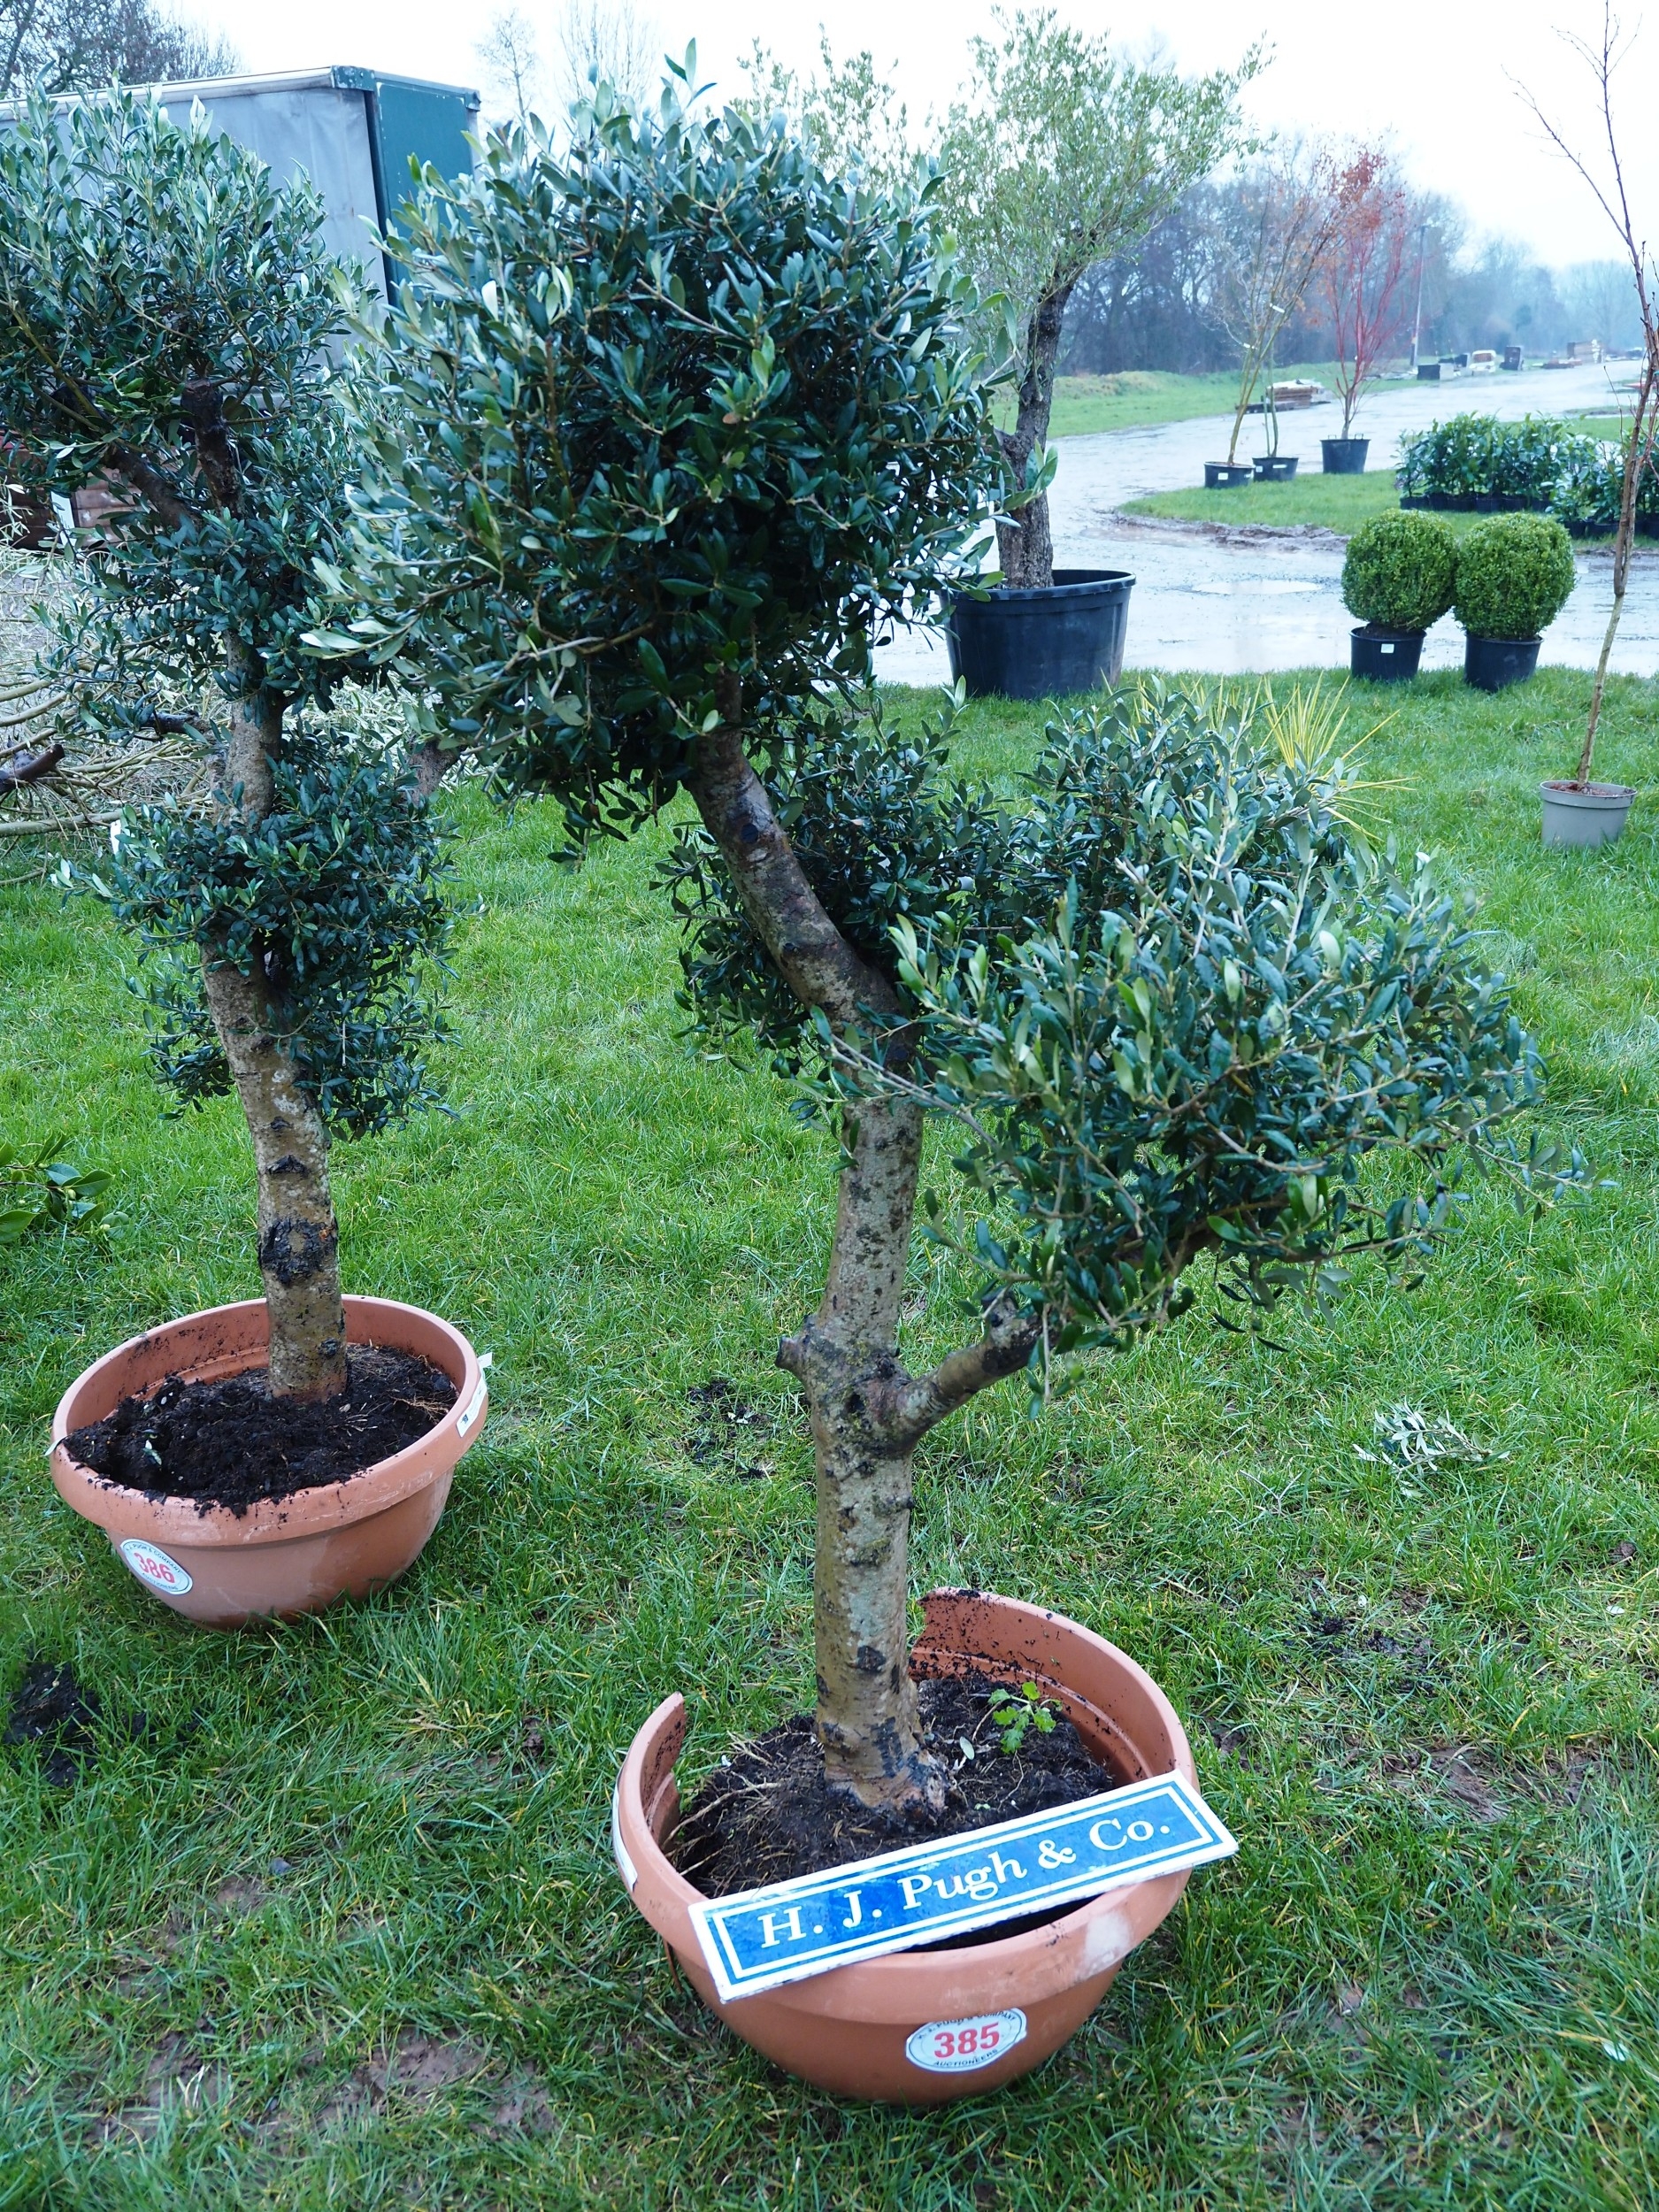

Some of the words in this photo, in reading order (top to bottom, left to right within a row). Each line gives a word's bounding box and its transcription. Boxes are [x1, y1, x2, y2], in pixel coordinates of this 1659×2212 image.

[134, 1552, 175, 1584] 386
[757, 1905, 824, 1948] H.
[842, 1890, 882, 1928] J.
[896, 1850, 1028, 1910] Pugh
[1037, 1839, 1077, 1870] &
[1088, 1817, 1171, 1851] Co.
[933, 2021, 1000, 2059] 385
[933, 2048, 998, 2066] AUCTIONEERS
